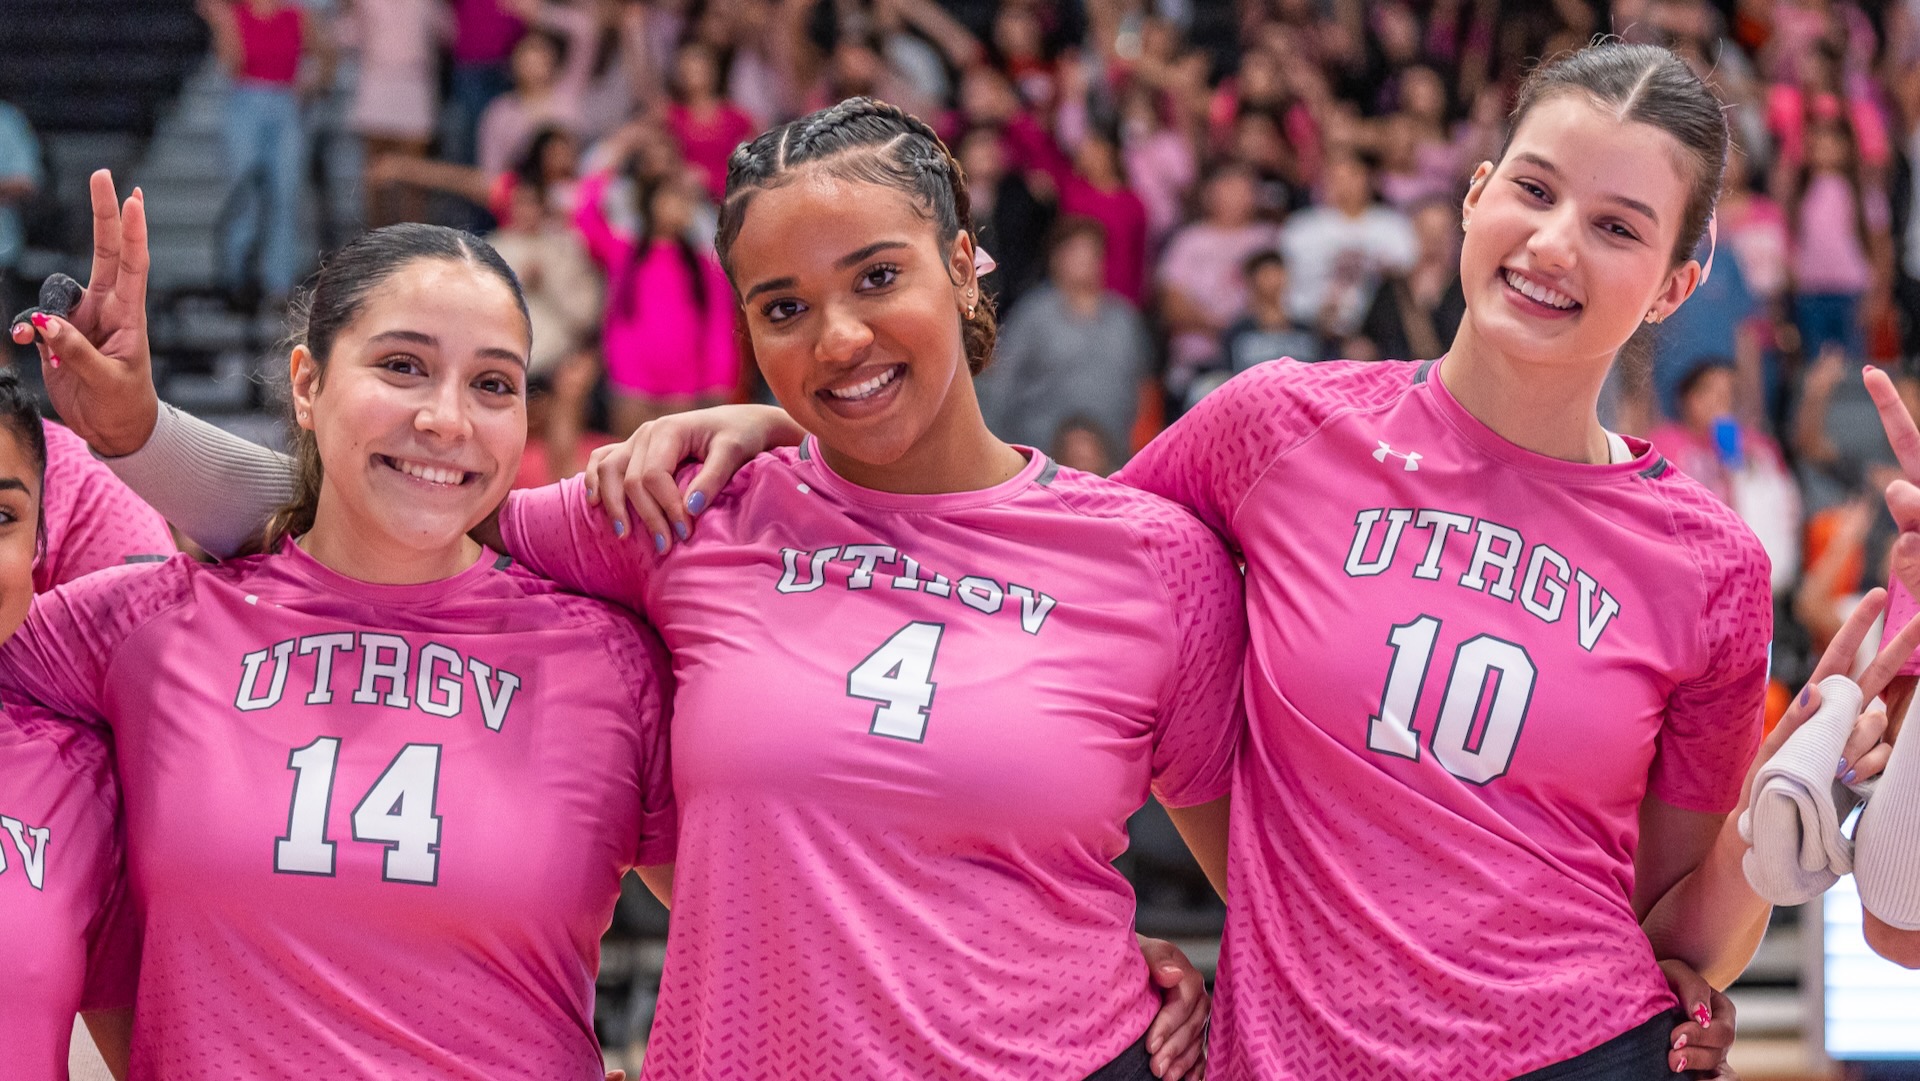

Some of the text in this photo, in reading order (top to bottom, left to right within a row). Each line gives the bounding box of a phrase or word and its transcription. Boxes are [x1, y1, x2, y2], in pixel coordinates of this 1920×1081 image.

[1344, 508, 1620, 651] UTRGV
[235, 632, 521, 731] UTRGV
[847, 620, 945, 742] 4
[1367, 614, 1538, 785] 10
[0, 814, 50, 891] V
[274, 737, 443, 886] 14
